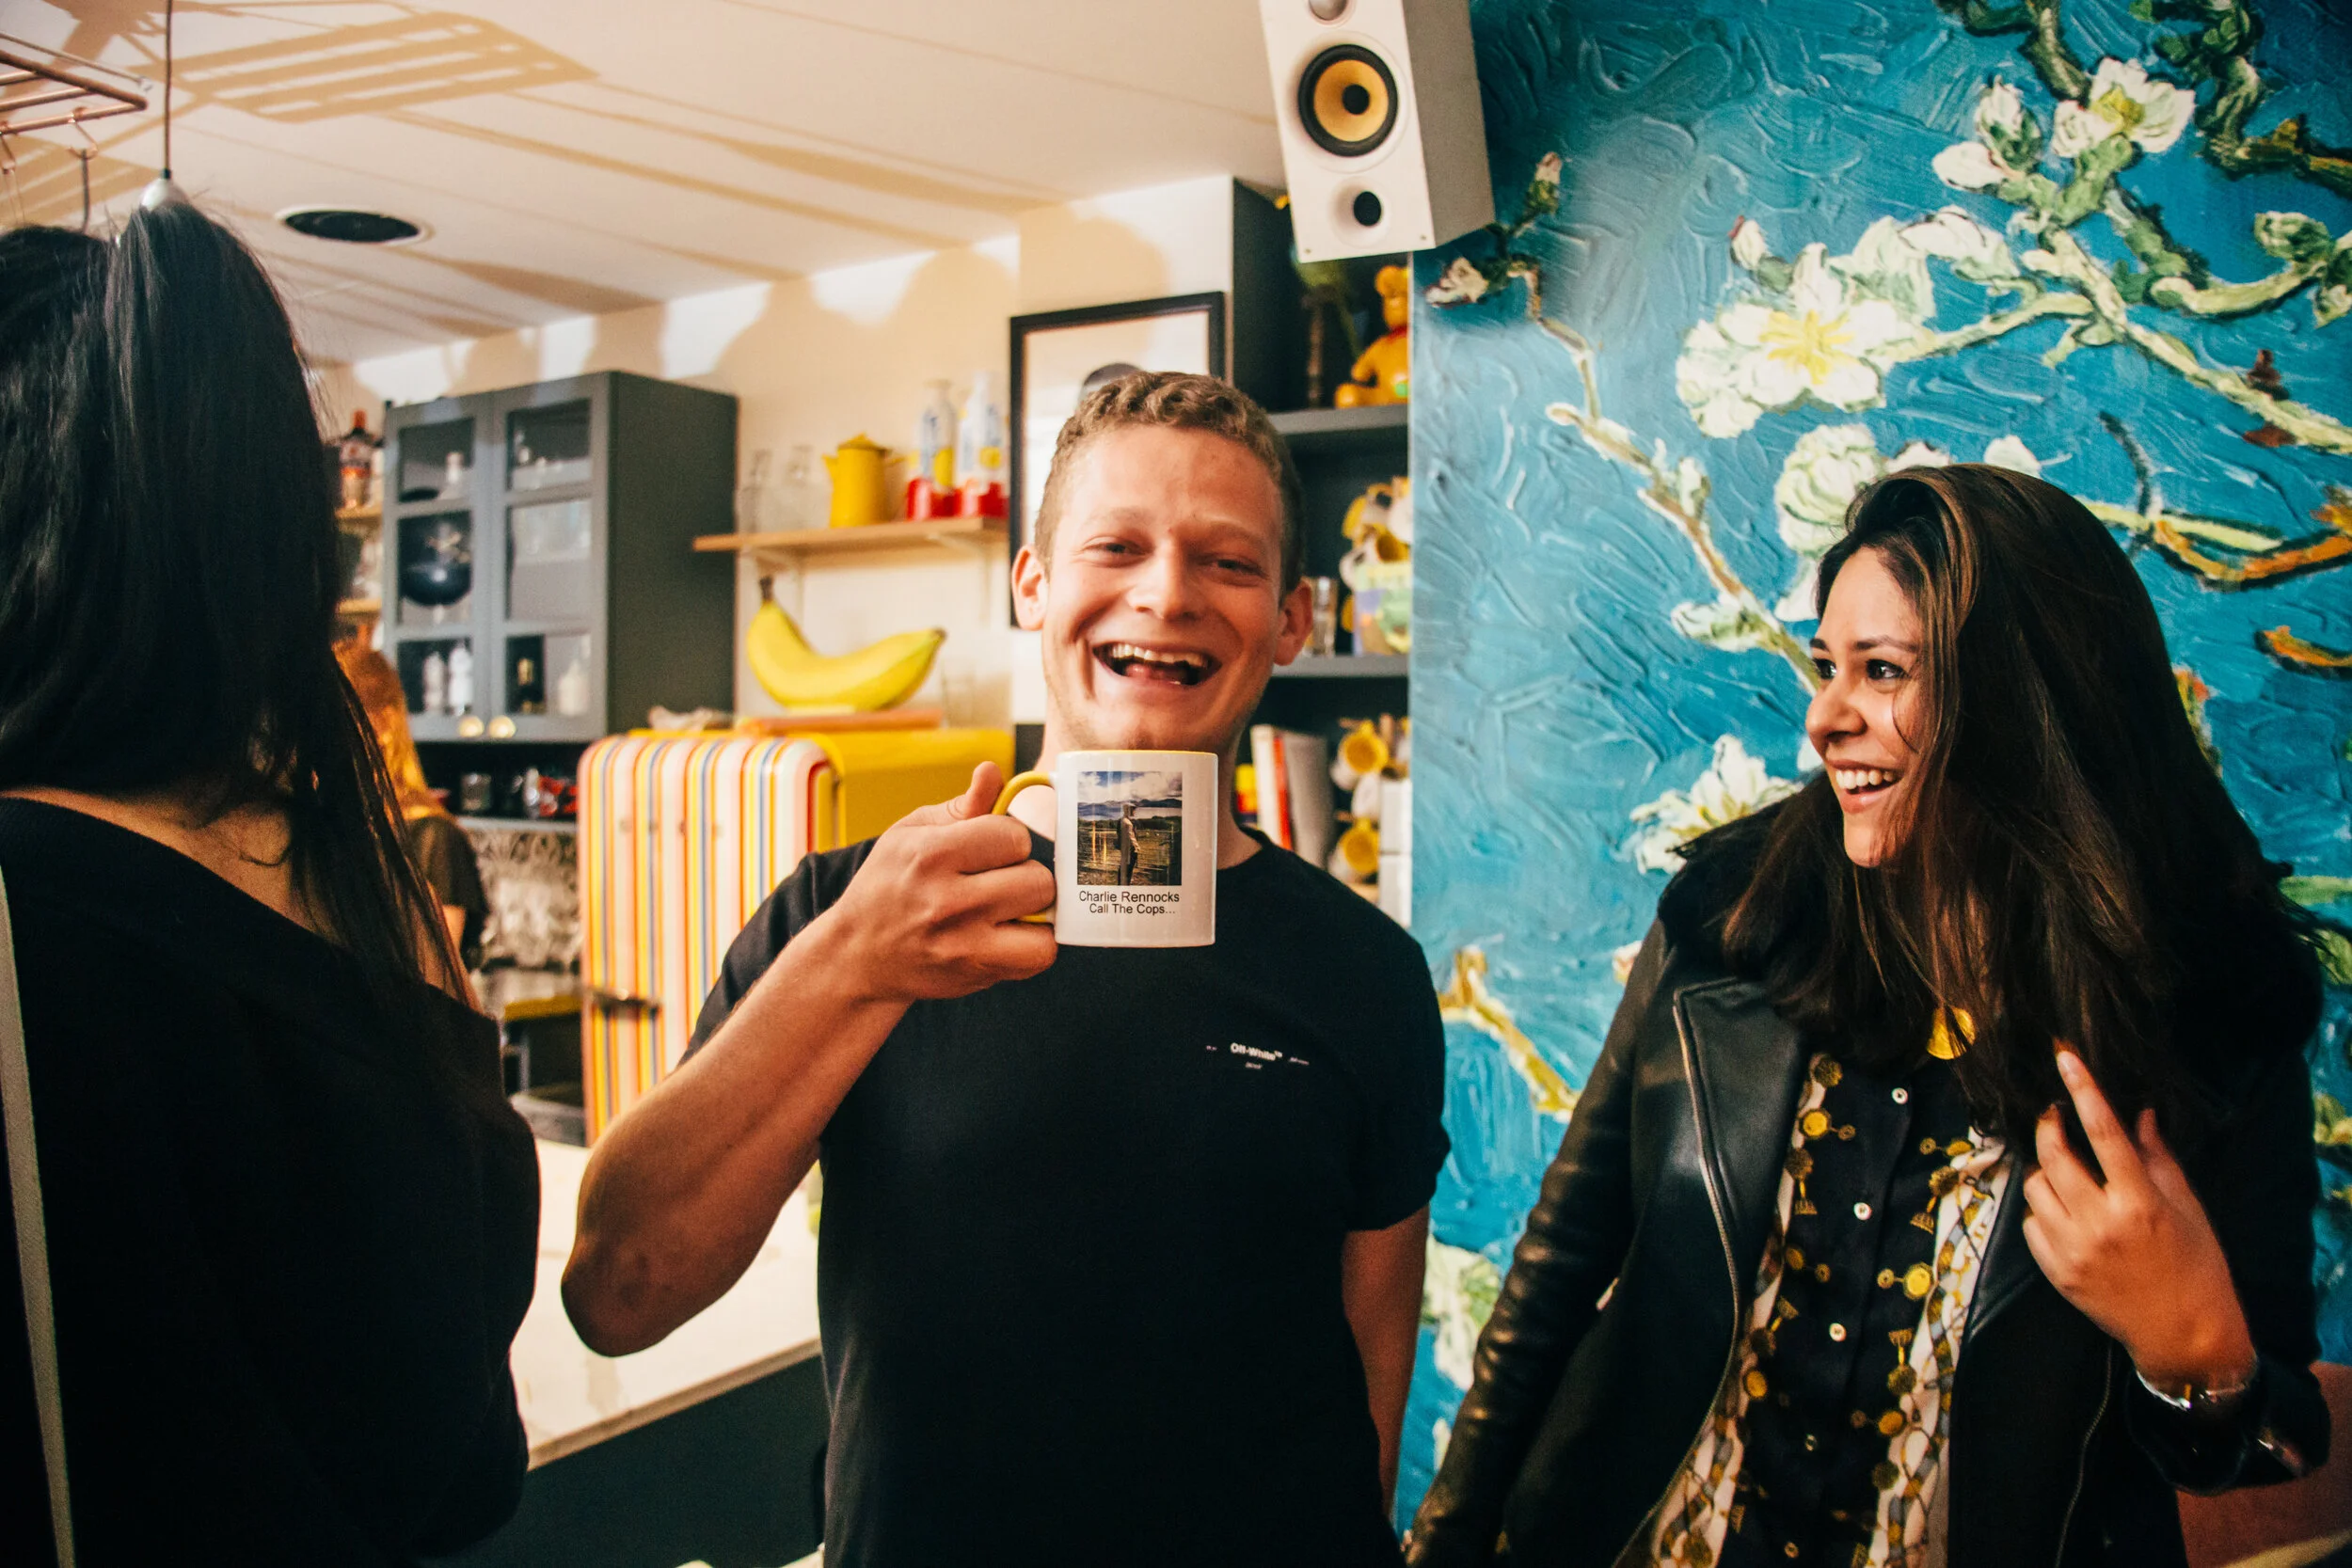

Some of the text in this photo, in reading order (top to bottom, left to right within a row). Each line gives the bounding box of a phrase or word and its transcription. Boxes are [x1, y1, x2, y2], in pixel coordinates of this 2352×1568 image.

[1079, 890, 1180, 903] Charlie Rennocks
[1089, 903, 1108, 913] Call
[1112, 904, 1133, 914] The
